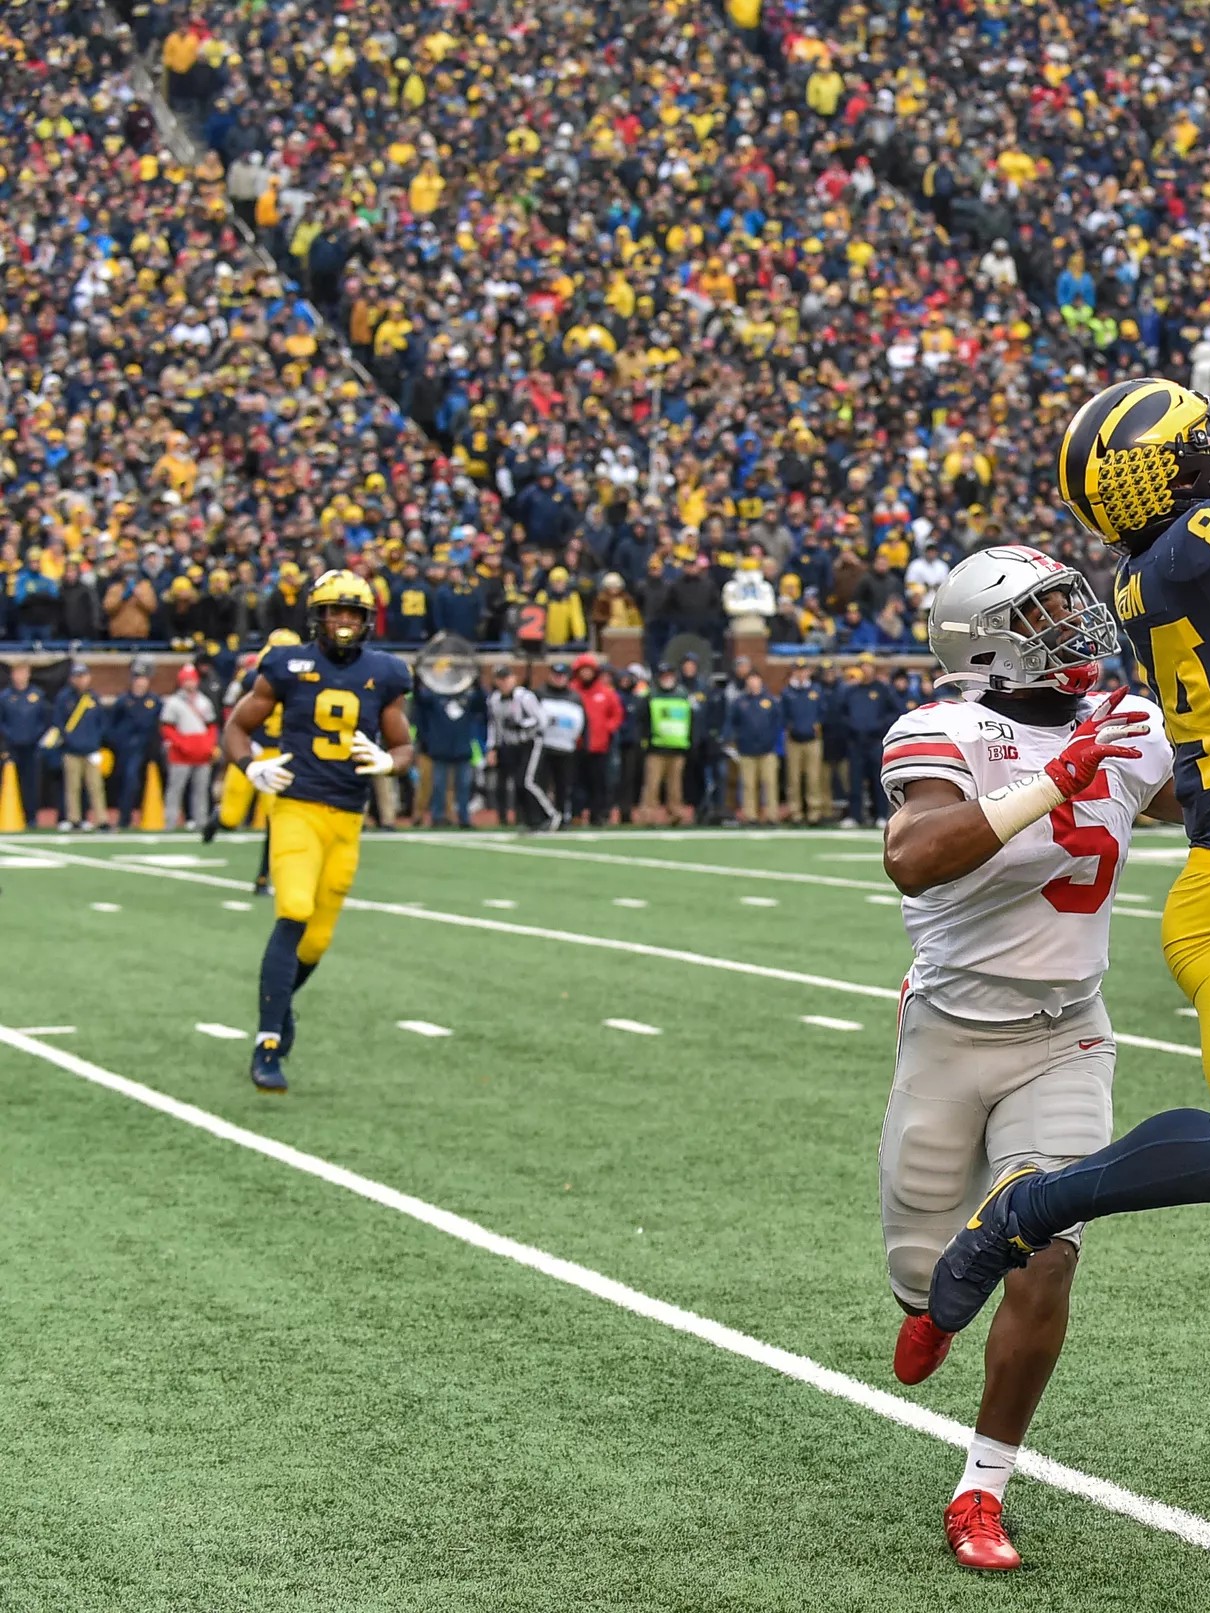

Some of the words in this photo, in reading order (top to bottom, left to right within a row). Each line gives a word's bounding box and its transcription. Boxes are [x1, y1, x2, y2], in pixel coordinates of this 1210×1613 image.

[517, 605, 546, 640] 2
[312, 687, 361, 761] 9
[1041, 768, 1119, 914] 5
